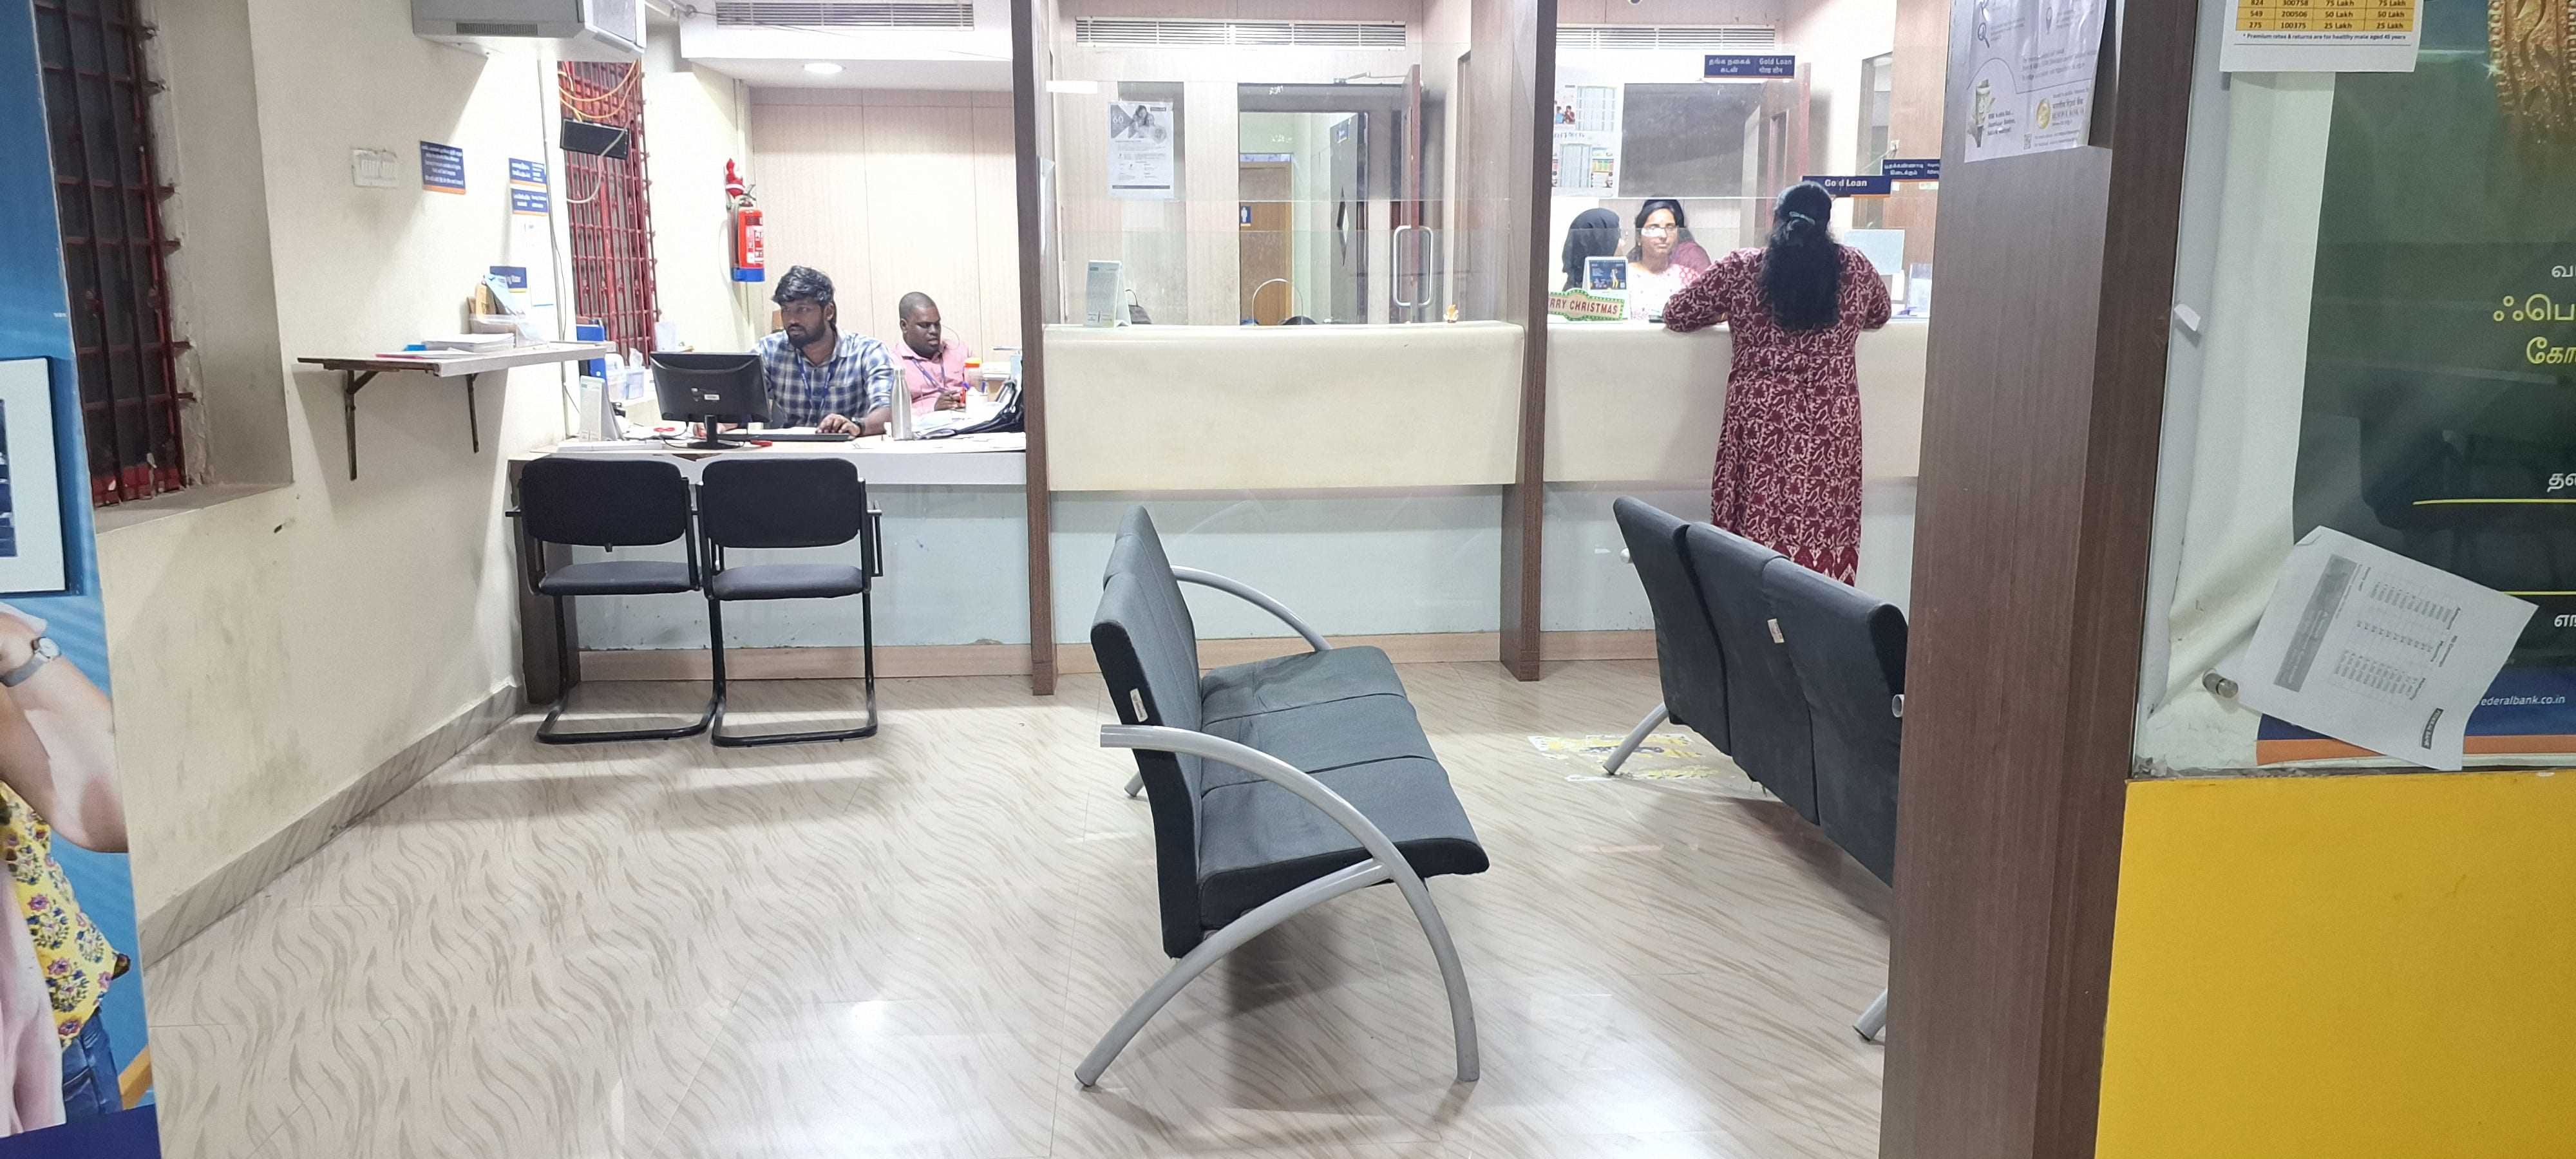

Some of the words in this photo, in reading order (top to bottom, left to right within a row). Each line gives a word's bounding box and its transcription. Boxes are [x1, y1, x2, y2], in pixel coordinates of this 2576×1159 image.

[1548, 297, 1567, 309] RRY
[1569, 299, 1618, 315] CHRISTMAS
[2480, 695, 2566, 706] ederalbank.co.in
